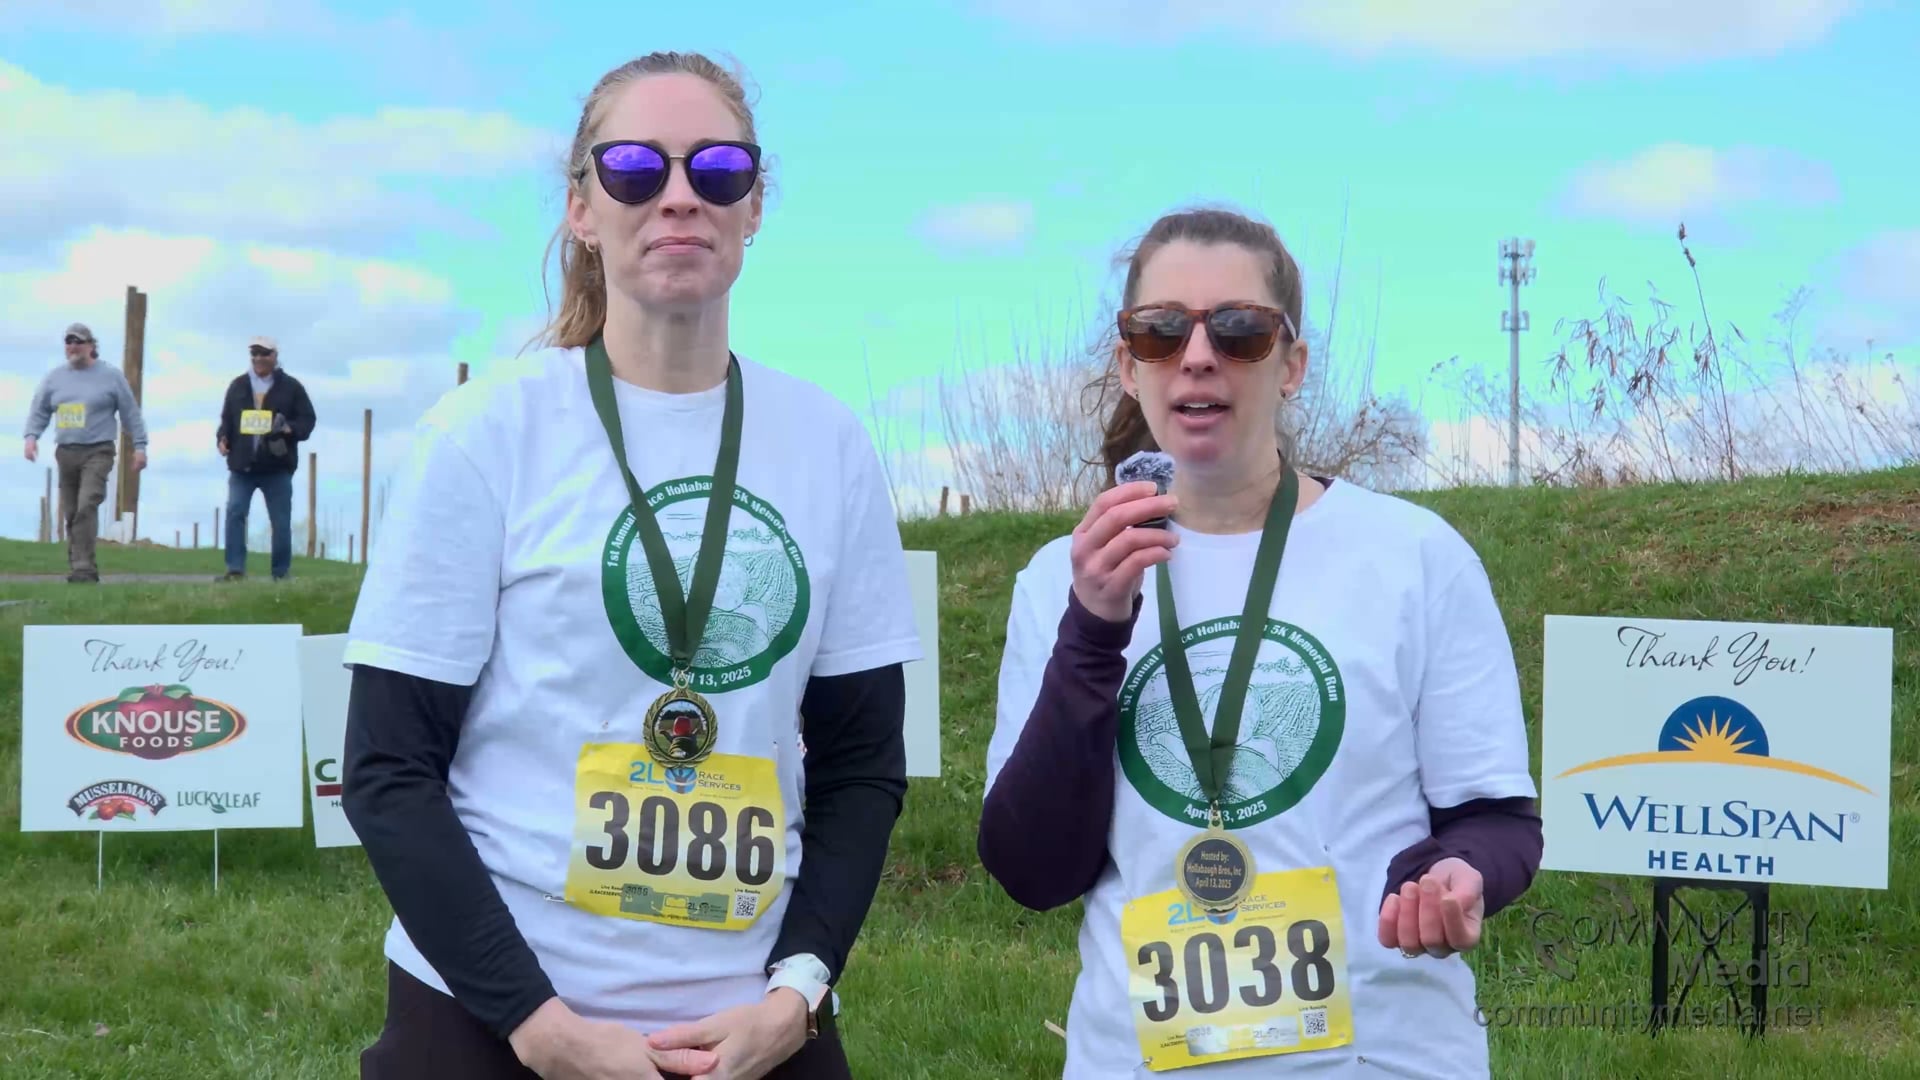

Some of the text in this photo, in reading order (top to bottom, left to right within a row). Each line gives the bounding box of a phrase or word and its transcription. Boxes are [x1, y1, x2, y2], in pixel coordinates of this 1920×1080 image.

[665, 481, 713, 496] Hollaba
[733, 489, 749, 504] 5K
[610, 512, 637, 549] Annual
[607, 550, 620, 567] 1st
[788, 546, 803, 568] Run
[84, 639, 243, 682] Thank You!
[1617, 626, 1815, 686] Thank You!
[699, 674, 718, 687] 13,
[721, 666, 752, 685] 2025
[1121, 695, 1133, 712] 1st
[1127, 654, 1159, 692] Annual
[1270, 625, 1289, 637] 5K
[1288, 631, 1333, 674] Memorial
[1324, 676, 1338, 702] Run
[91, 710, 222, 734] KNOUSE
[119, 736, 194, 748] FOODS
[629, 761, 665, 784] 2L
[698, 771, 725, 781] RACE
[73, 782, 162, 809] MUSSELMAN'S
[697, 780, 742, 791] SERVICES
[1217, 810, 1234, 823] 3,
[1236, 799, 1268, 820] 2025
[585, 791, 775, 886] 3086
[1649, 849, 1775, 876] HEALTH
[1195, 877, 1209, 889] April
[1240, 901, 1286, 912] SERVICES
[1243, 894, 1268, 904] ACE
[1168, 901, 1206, 926] 2L
[1138, 919, 1335, 1022] 3038
